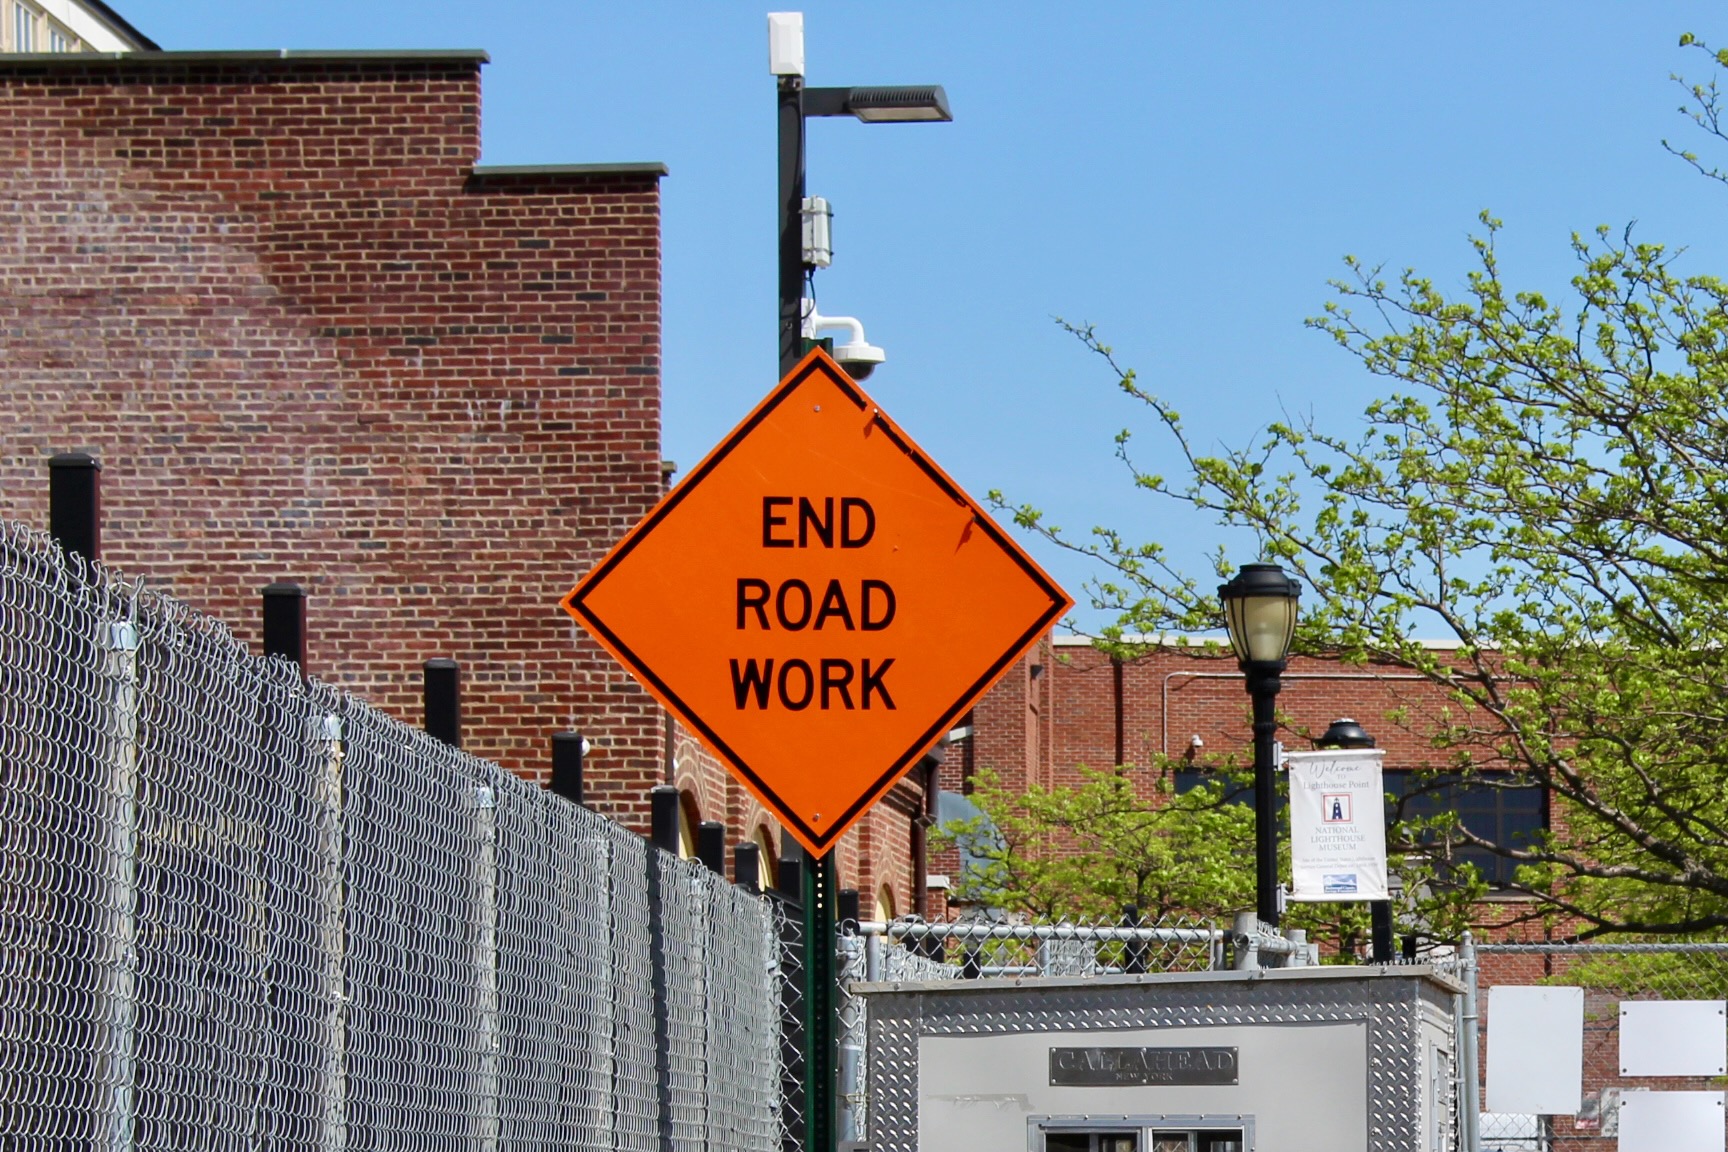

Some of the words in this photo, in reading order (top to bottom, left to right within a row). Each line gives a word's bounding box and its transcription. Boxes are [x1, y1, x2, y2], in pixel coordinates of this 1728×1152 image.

[762, 496, 877, 549] END
[736, 577, 898, 632] ROAD
[728, 657, 898, 712] WORK
[1309, 760, 1361, 779] Welcome
[1303, 781, 1347, 791] Lighthouse
[1348, 780, 1369, 789] Point
[1315, 826, 1360, 834] NATIONAL
[1310, 834, 1365, 843] LIGHTHOUSE
[1318, 843, 1357, 851] MUSEUM
[1058, 1050, 1235, 1071] CALLAHEAD
[1115, 1072, 1139, 1081] NEW
[1142, 1072, 1174, 1081] YORK
